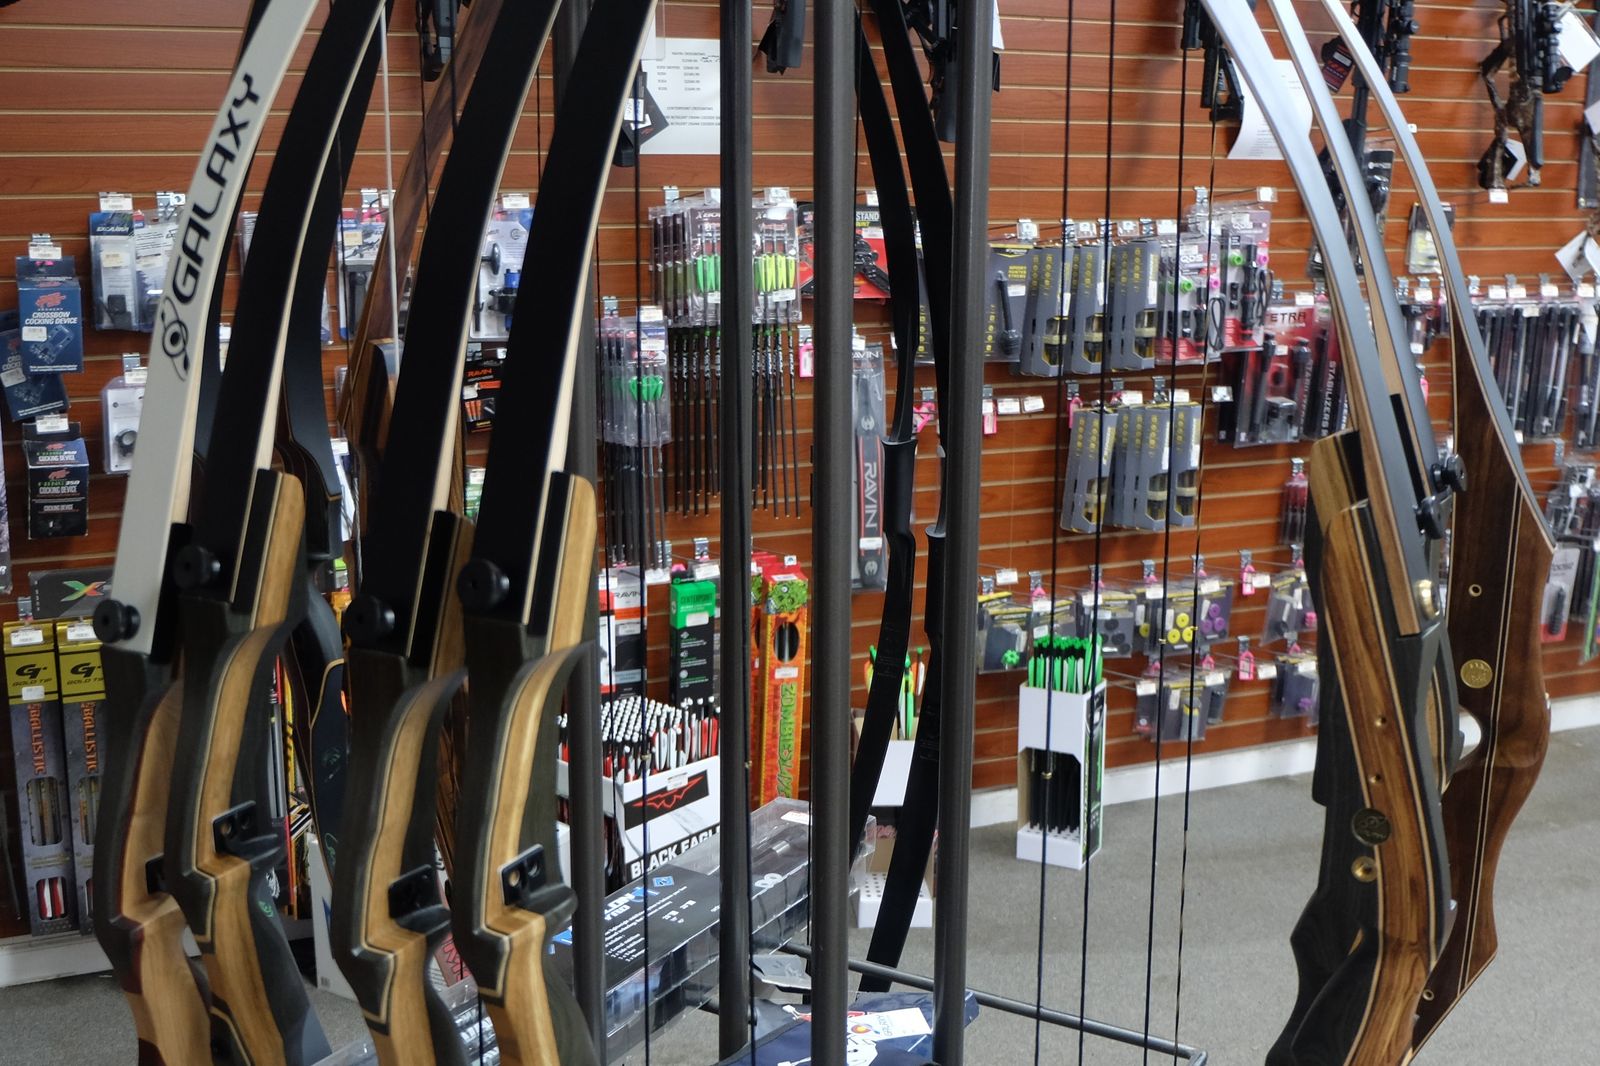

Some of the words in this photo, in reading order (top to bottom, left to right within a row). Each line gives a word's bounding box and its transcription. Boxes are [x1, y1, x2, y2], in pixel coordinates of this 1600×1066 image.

[172, 73, 260, 304] GALAXY
[32, 311, 70, 319] CROSSBOW
[55, 317, 78, 325] DEVICE
[1321, 360, 1337, 428] STABILIZERS
[864, 462, 878, 530] RAVIN
[30, 708, 47, 775] BALLISTIC
[83, 708, 99, 774] BALLISTIC
[630, 842, 681, 879] BLACK
